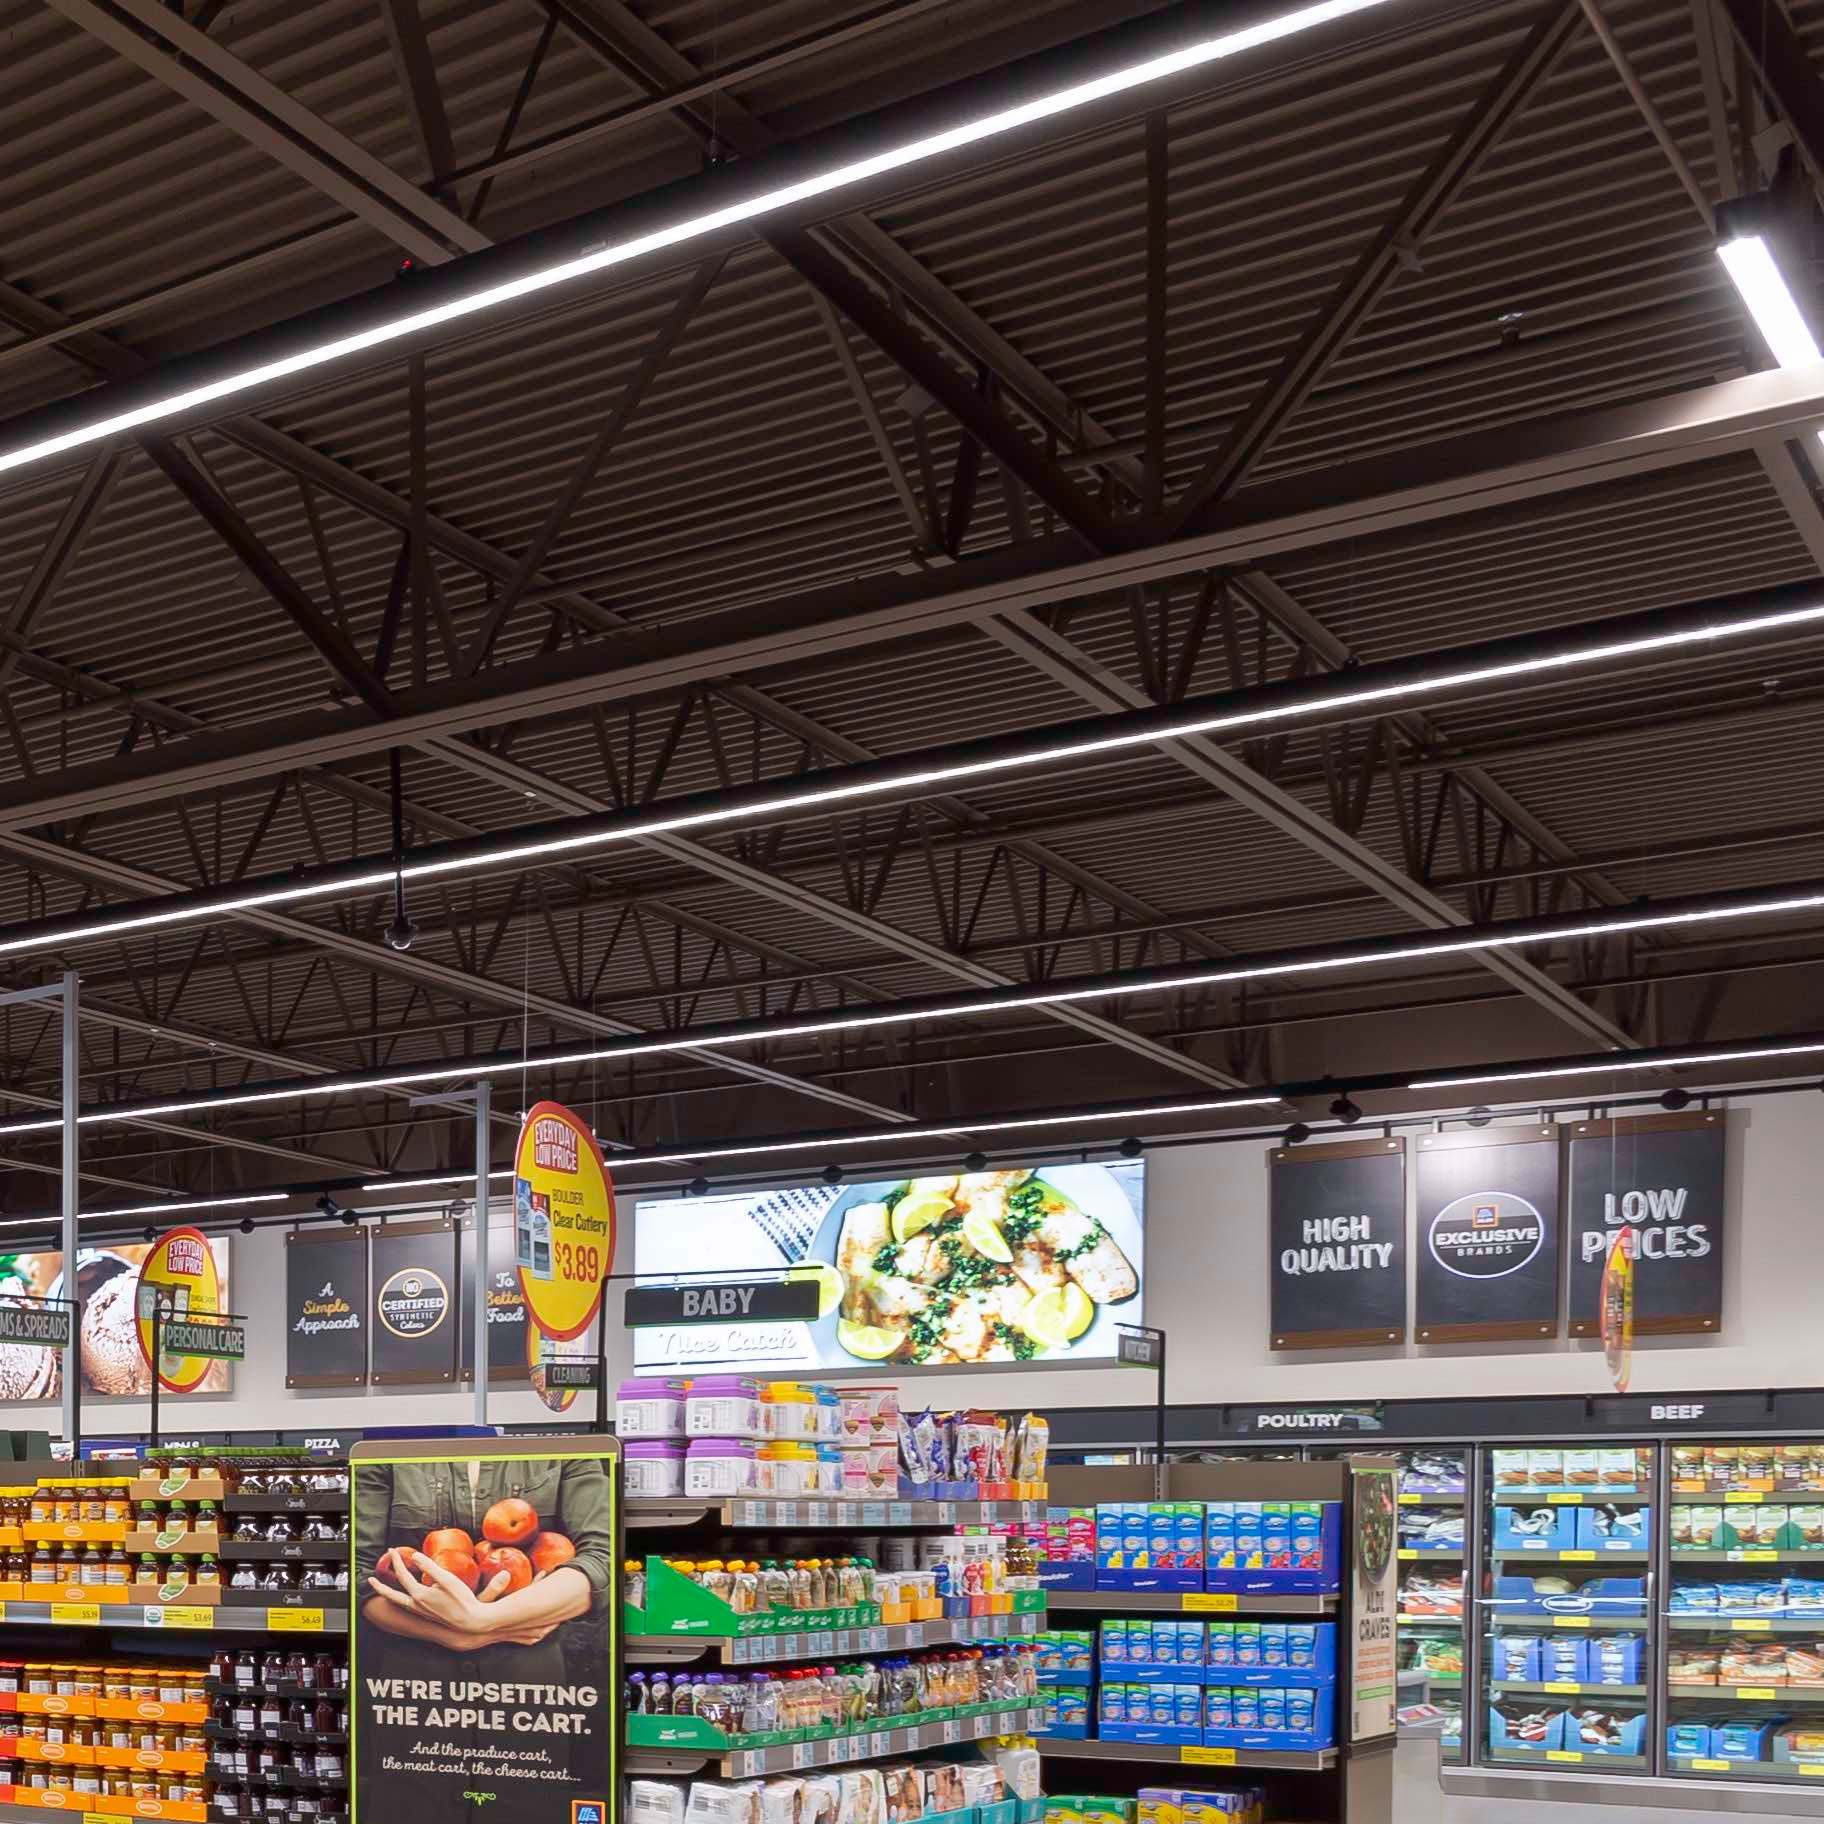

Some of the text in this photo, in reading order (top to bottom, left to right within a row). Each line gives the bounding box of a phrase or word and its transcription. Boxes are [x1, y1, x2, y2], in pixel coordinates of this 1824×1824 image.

[536, 1120, 577, 1152] EVERYDAY
[536, 1146, 577, 1171] LOW PRICE
[552, 1189, 584, 1206] BOULDER
[1605, 1188, 1688, 1225] LOW
[553, 1210, 607, 1236] Clear Cutlery
[1303, 1215, 1370, 1243] HIGH
[1436, 1228, 1538, 1246] EXCLUSIVE
[169, 1240, 203, 1257] EVERYDAY
[1457, 1245, 1513, 1257] BRANDS
[169, 1257, 203, 1275] LOW PRICE
[555, 1240, 598, 1283] $3.89
[1281, 1241, 1393, 1276] QUALITY
[318, 1282, 334, 1297] A
[495, 1272, 515, 1288] To
[303, 1298, 350, 1316] Simple
[382, 1298, 445, 1311] CERTIFIED
[683, 1288, 755, 1316] BABY
[293, 1314, 360, 1335] Approach
[390, 1311, 434, 1321] SYNTHETIC
[487, 1307, 525, 1324] Food
[16, 1316, 24, 1336] &
[25, 1315, 69, 1340] SPREADS
[166, 1325, 244, 1353] PERSONAL CARE
[552, 1367, 591, 1383] CLEANING
[1257, 1413, 1343, 1430] POULTRY
[1650, 1405, 1704, 1420] BEEF
[304, 1438, 340, 1448] PIZZA
[366, 1677, 598, 1707] WE'RE UPSETTING
[373, 1705, 593, 1735] THE APPLE CART.
[409, 1741, 552, 1765] And the produce cart,
[383, 1756, 583, 1782] the meat cart, the cheese cart...
